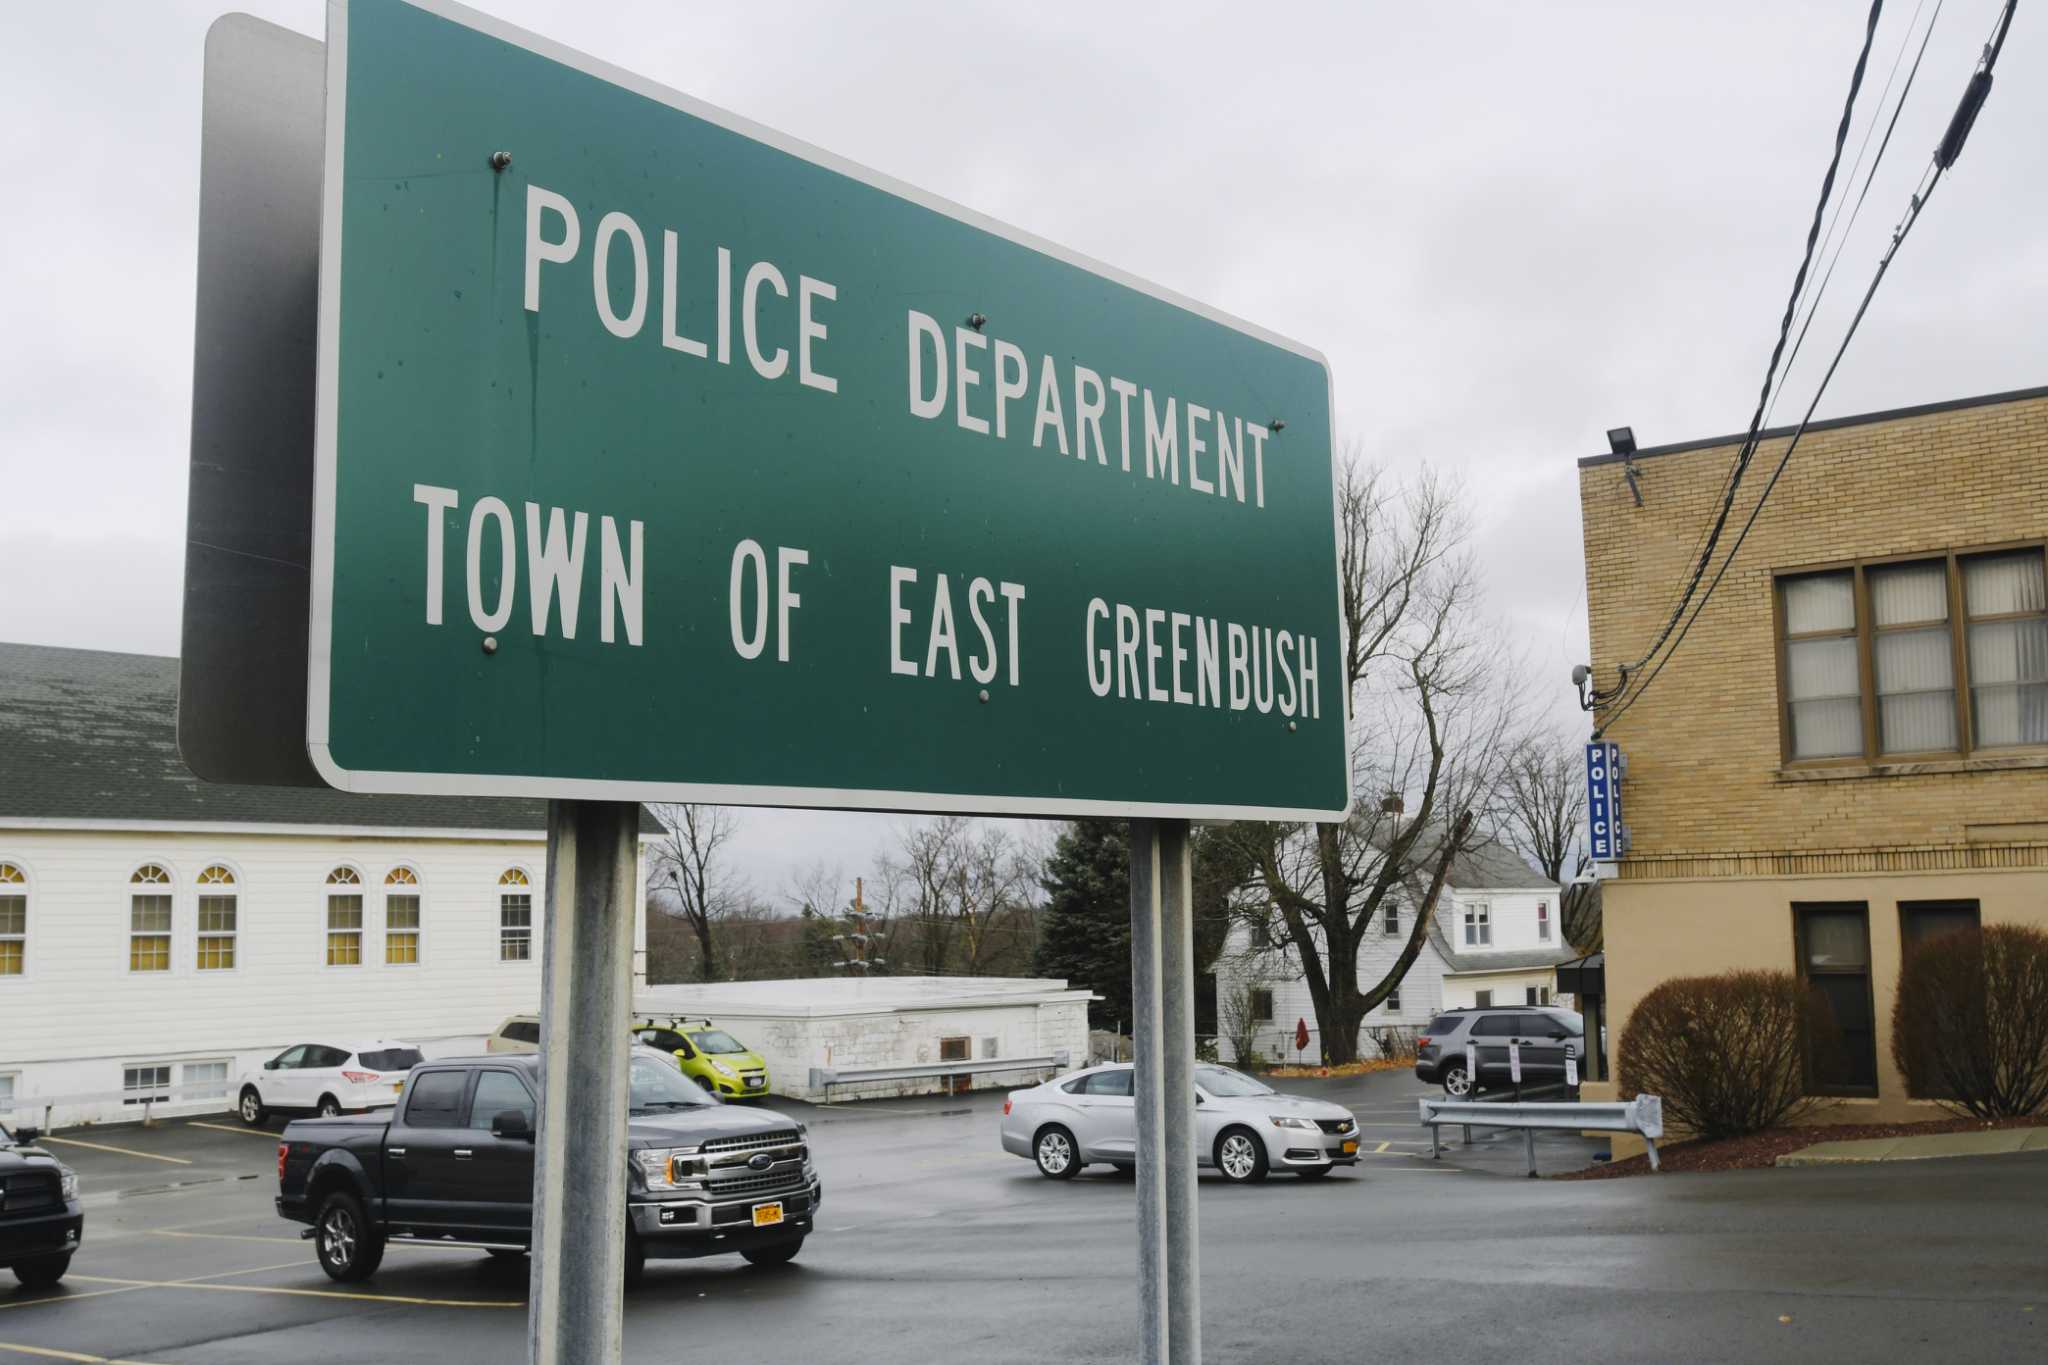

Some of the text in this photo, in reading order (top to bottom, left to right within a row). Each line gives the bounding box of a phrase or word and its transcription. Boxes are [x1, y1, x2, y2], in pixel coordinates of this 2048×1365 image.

[524, 183, 1269, 508] POLICE DEPARTMENT
[413, 483, 1320, 719] TOWN OF EAST GREENBUSH
[1591, 749, 1607, 853] POLICE
[1611, 748, 1622, 853] POLICE
